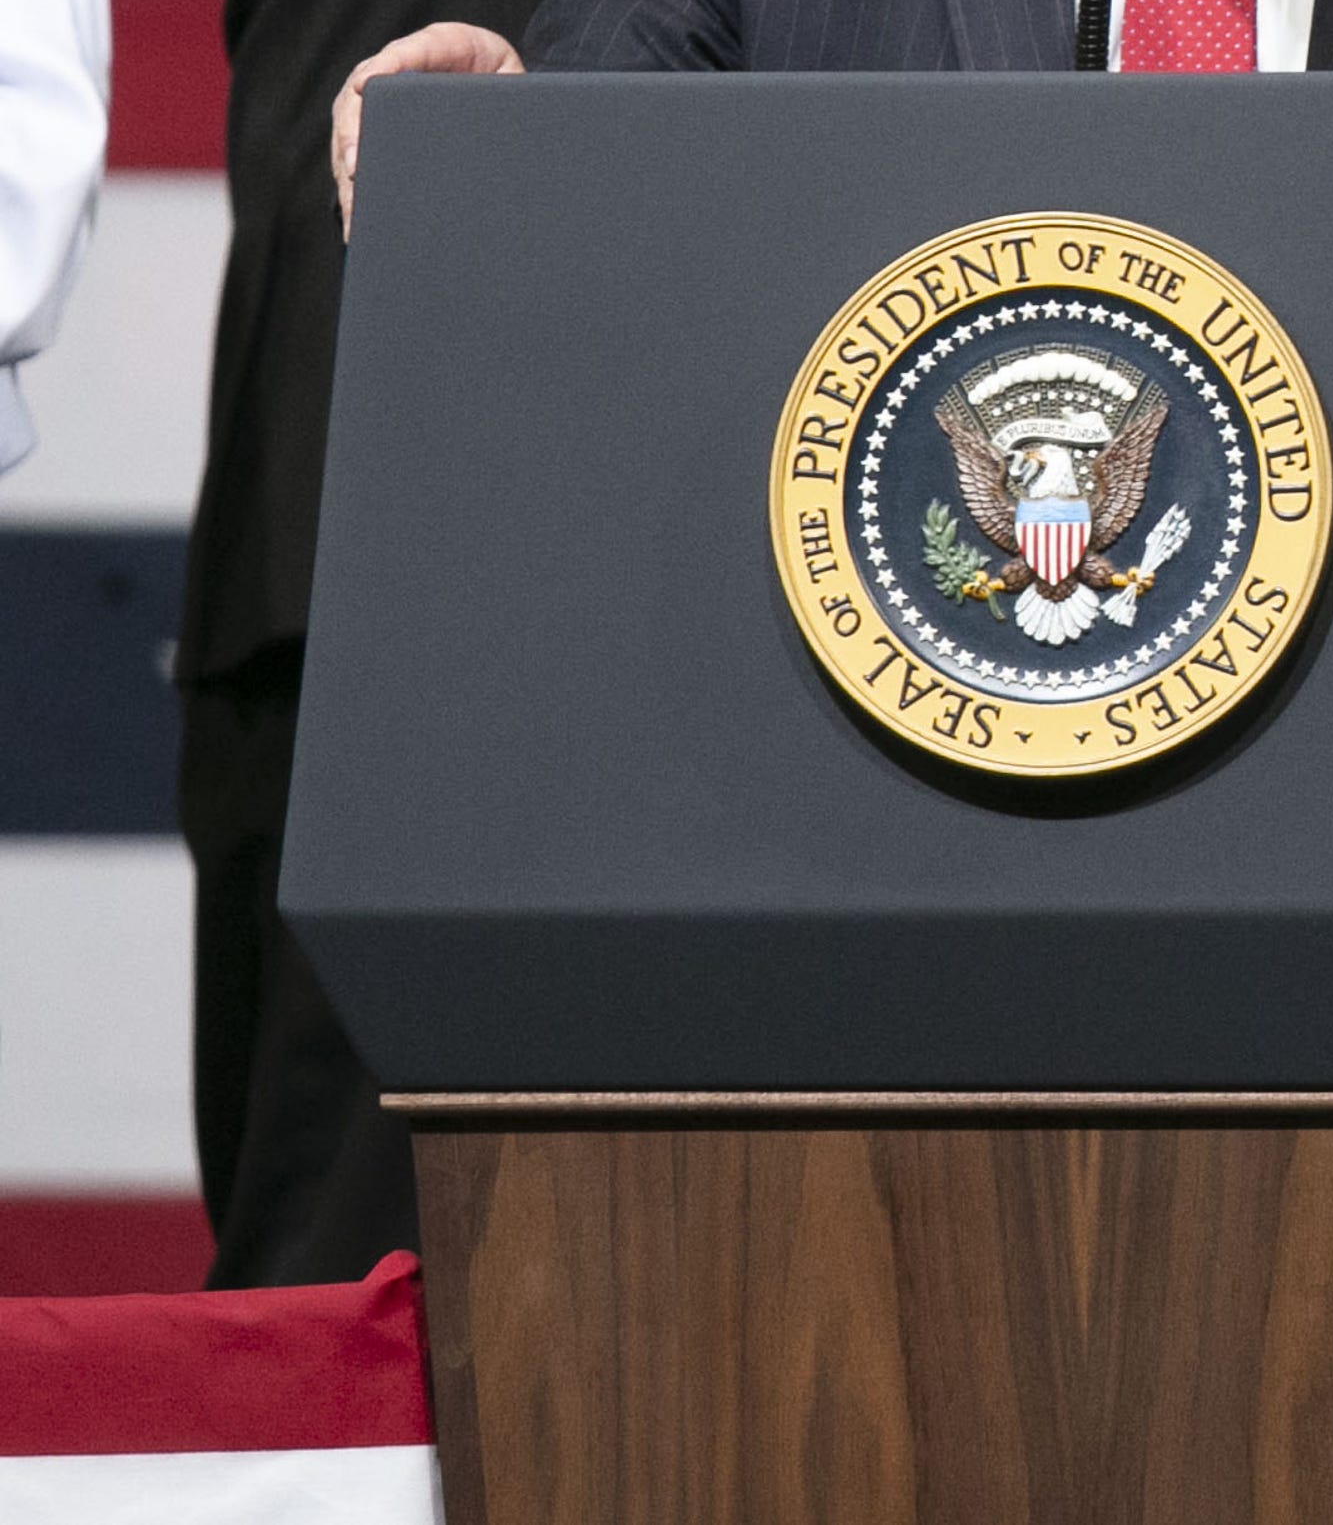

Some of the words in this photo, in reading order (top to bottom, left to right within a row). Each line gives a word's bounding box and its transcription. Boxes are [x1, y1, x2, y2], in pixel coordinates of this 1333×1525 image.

[1058, 240, 1105, 275] OF
[1119, 251, 1187, 304] THE
[792, 235, 1036, 484] PRESIDENT
[1200, 296, 1313, 523] UNITED
[799, 506, 841, 584] THE
[820, 592, 862, 638] OF
[1104, 575, 1290, 748] STATES
[863, 634, 1001, 749] SEAL
